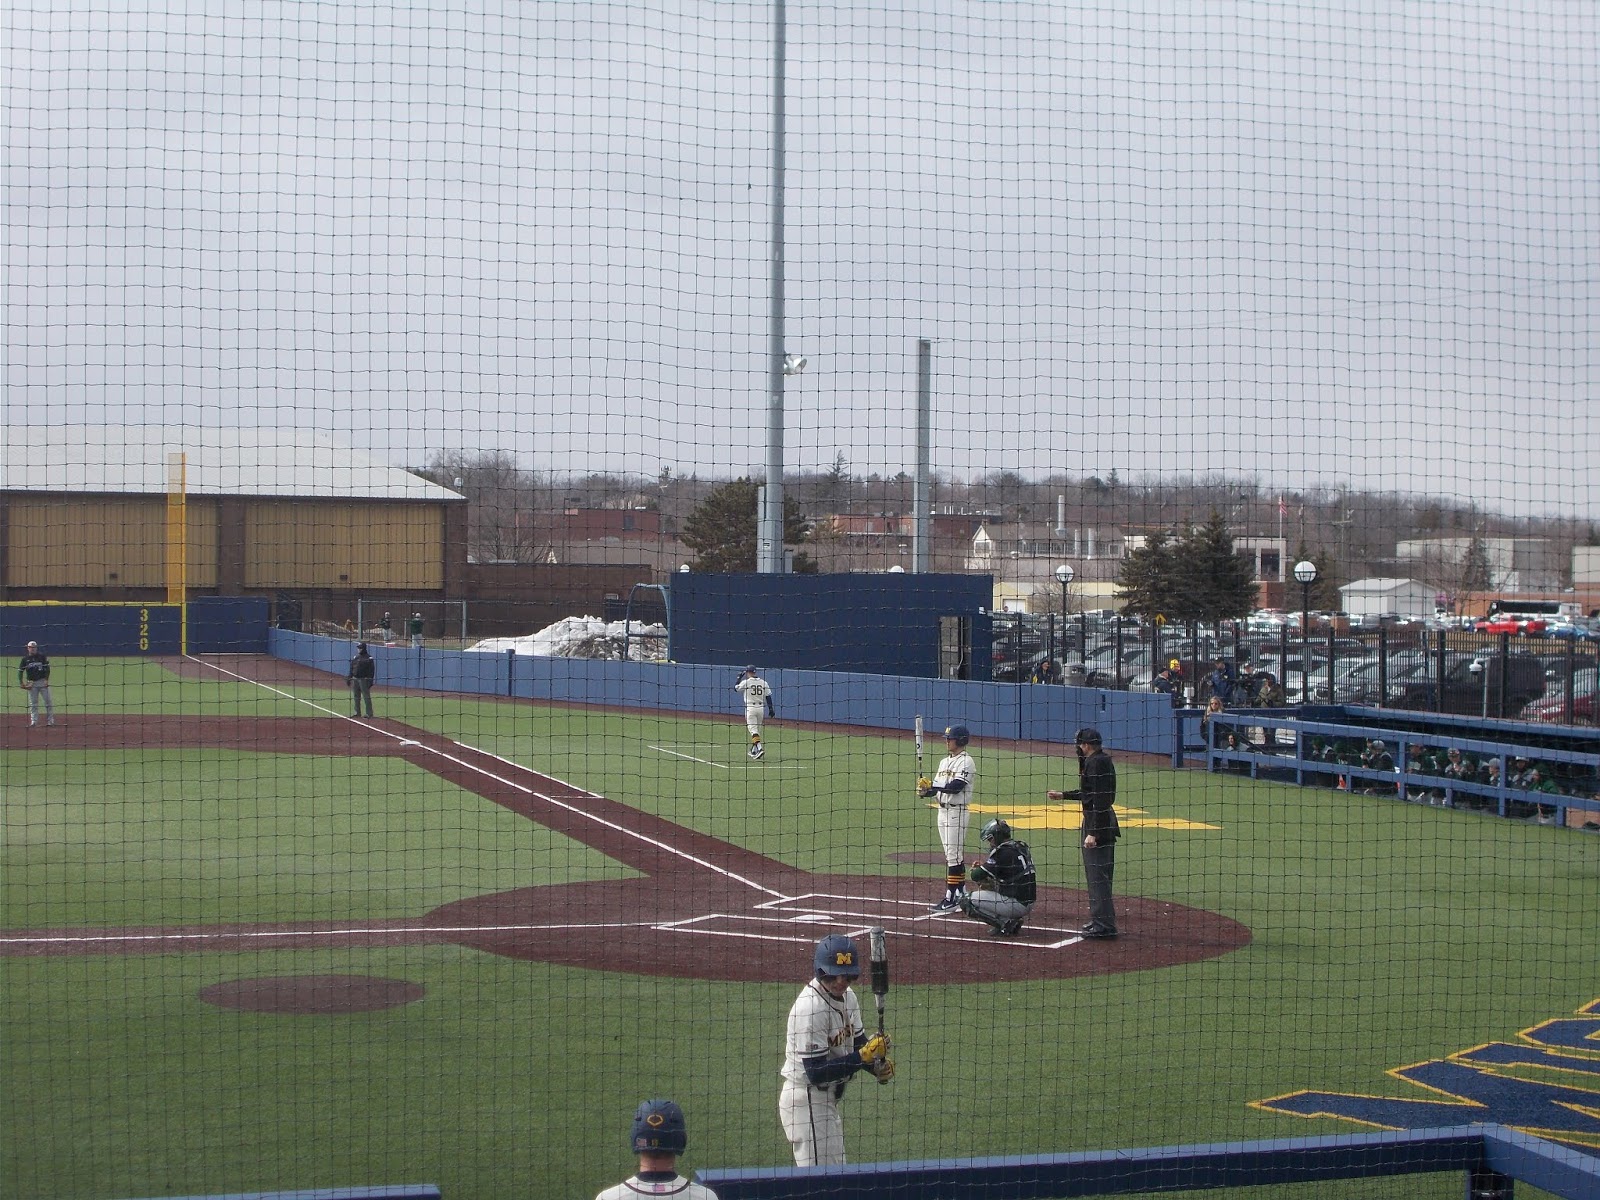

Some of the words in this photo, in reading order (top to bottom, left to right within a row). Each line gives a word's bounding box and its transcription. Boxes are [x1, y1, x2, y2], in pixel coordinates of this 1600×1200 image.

[140, 608, 149, 651] 320
[750, 684, 763, 696] 36
[836, 952, 852, 965] M
